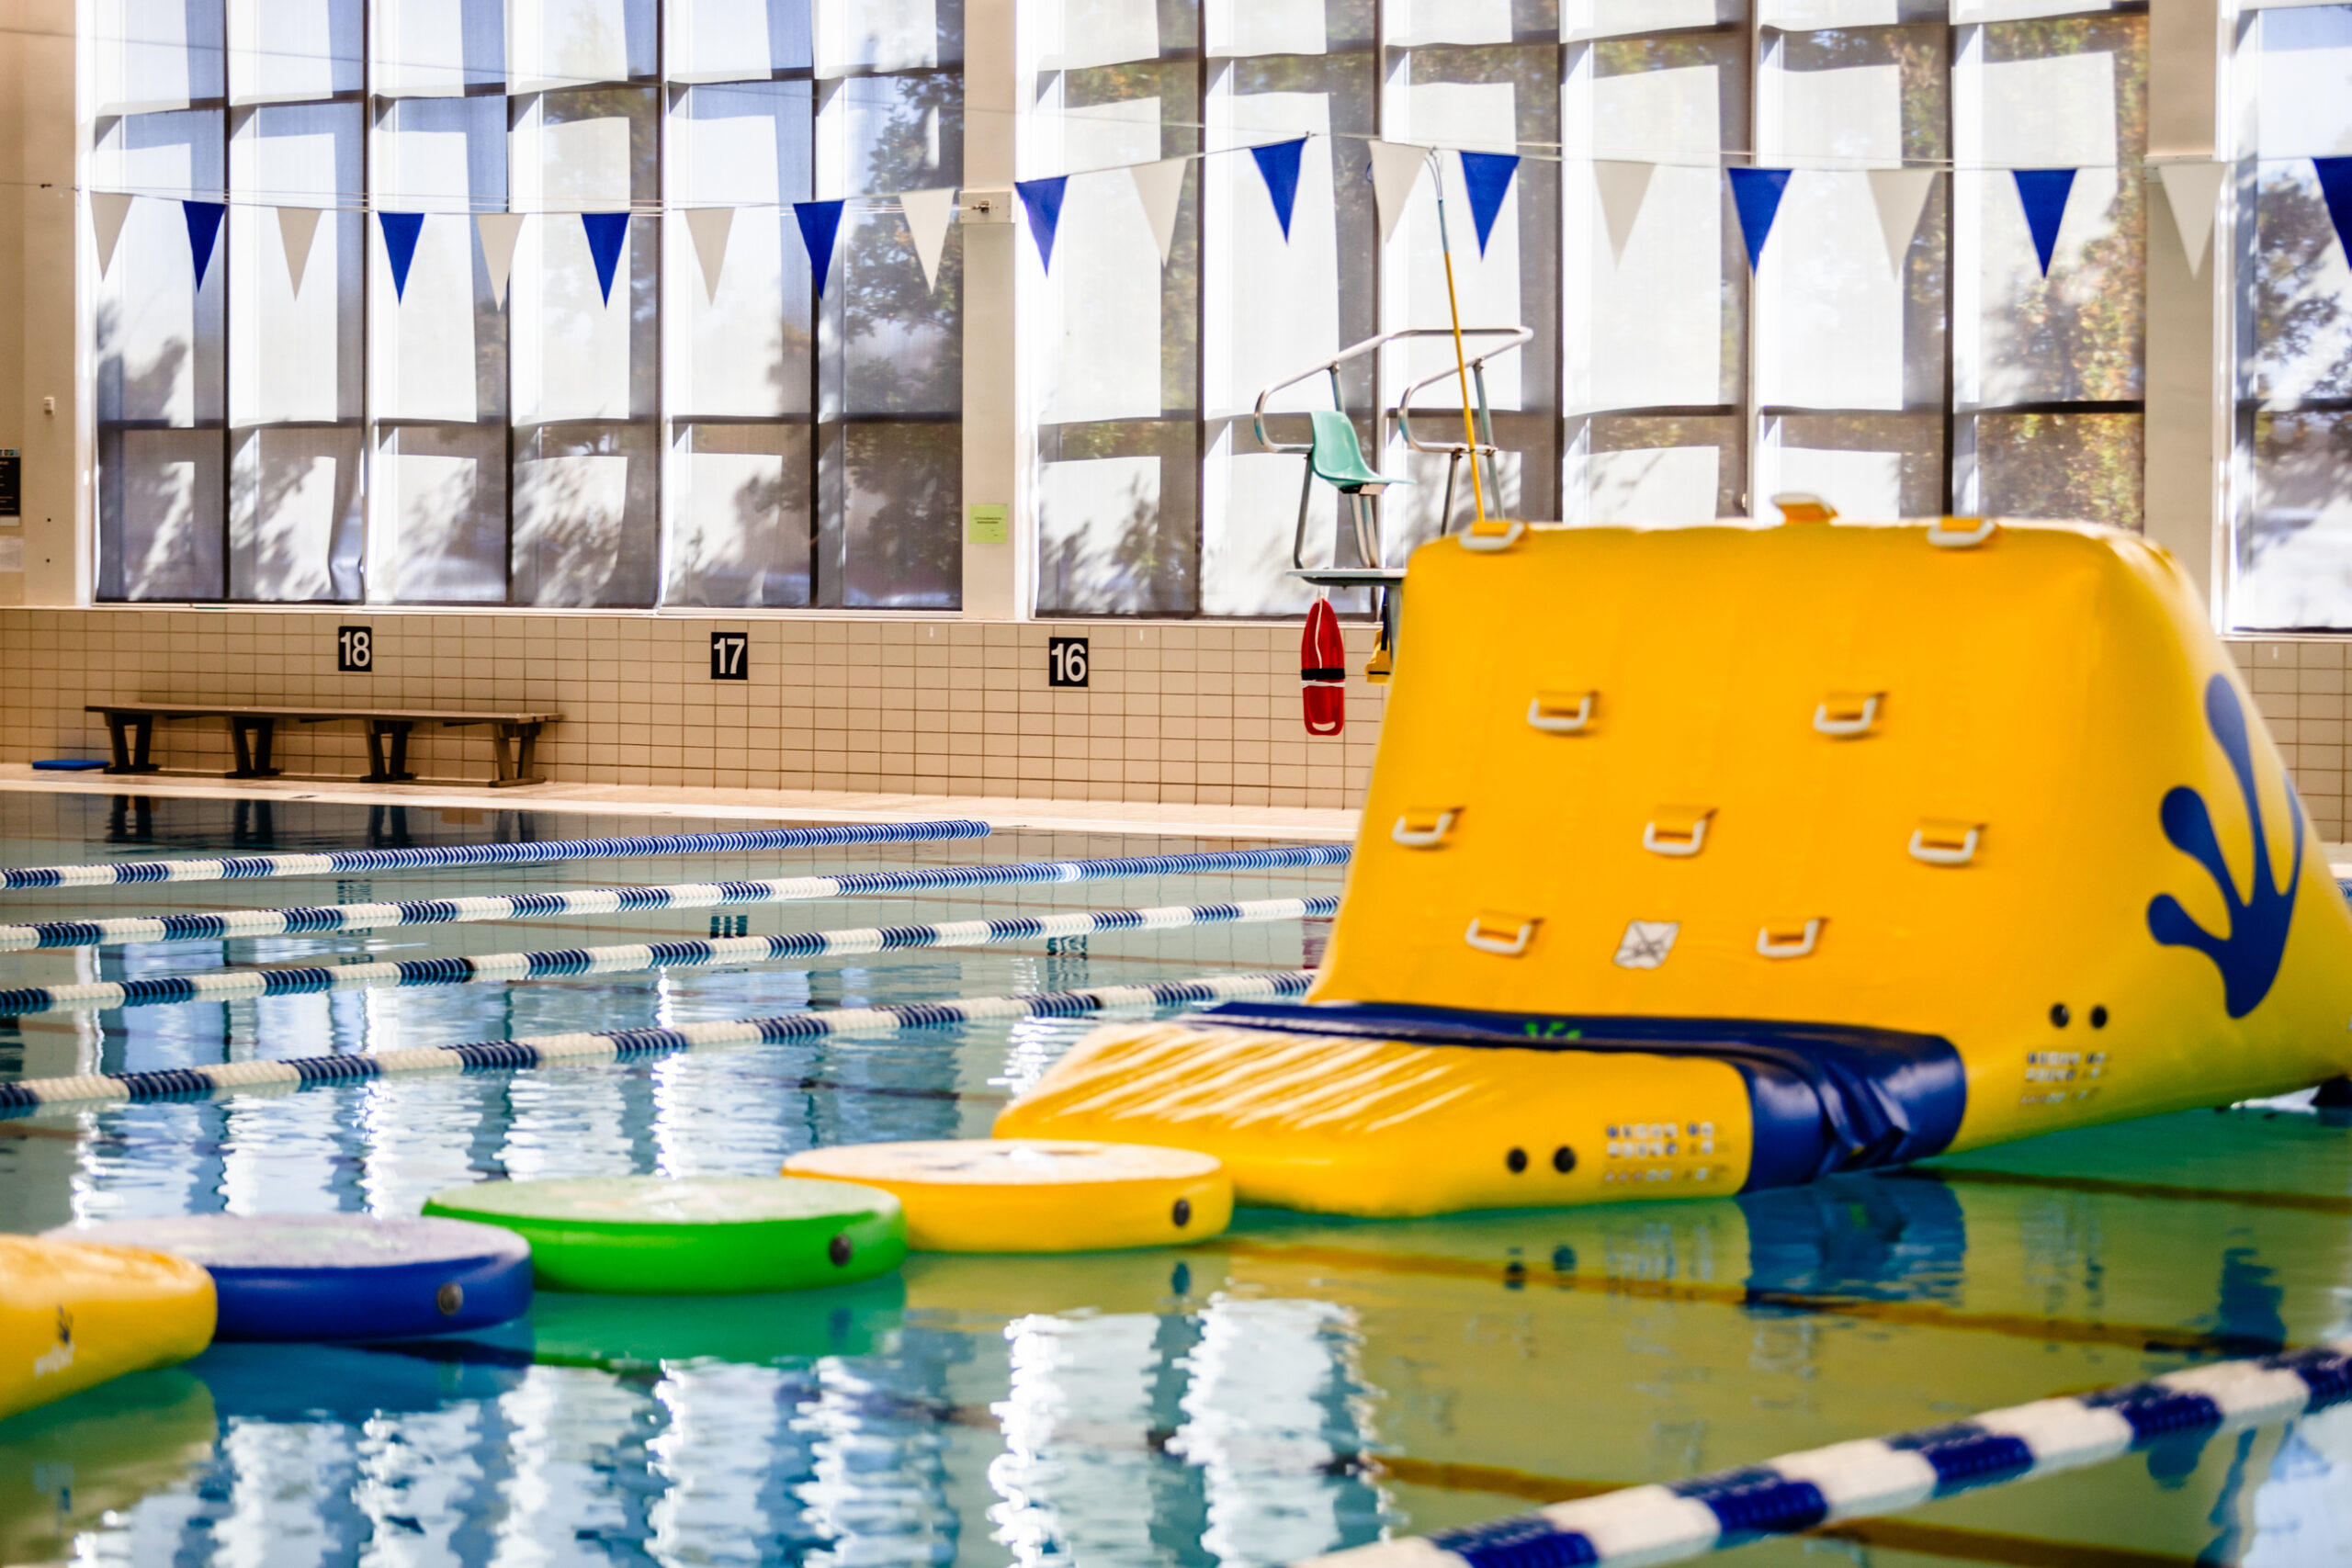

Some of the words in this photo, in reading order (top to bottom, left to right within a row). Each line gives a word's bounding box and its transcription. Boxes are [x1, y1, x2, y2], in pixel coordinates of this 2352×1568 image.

[340, 631, 370, 667] 18
[713, 637, 745, 674] 17
[1051, 643, 1087, 682] 16
